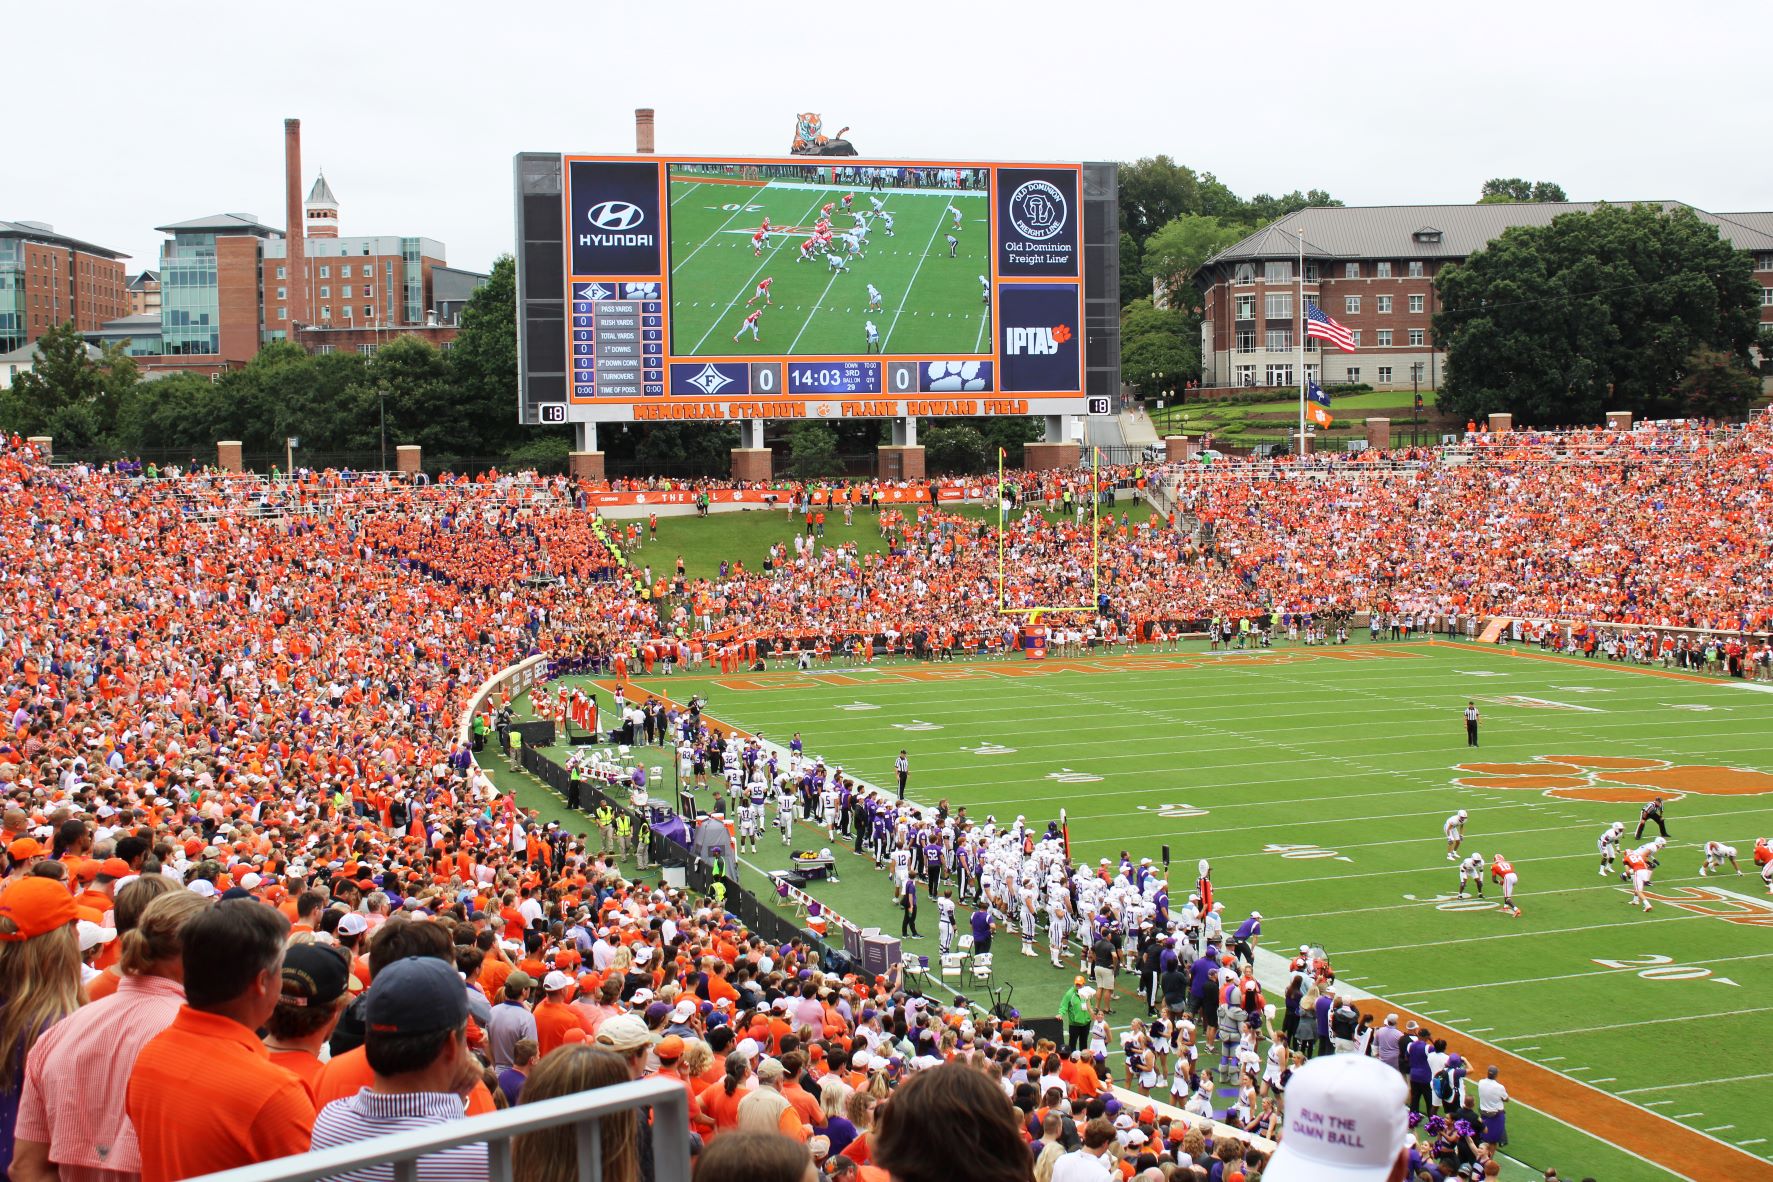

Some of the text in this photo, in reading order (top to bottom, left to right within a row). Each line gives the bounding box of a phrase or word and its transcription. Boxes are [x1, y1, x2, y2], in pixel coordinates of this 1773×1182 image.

[1015, 183, 1062, 203] OLD DOMINION
[1016, 220, 1061, 236] FREIGHT LINE
[580, 234, 653, 246] HYUNDAI
[1005, 242, 1072, 251] Old Dominion
[1009, 254, 1044, 266] Freight
[581, 304, 586, 312] 0
[649, 303, 655, 311] 0
[581, 317, 587, 325] 0
[649, 317, 655, 325] 0
[581, 332, 587, 340] 0
[650, 331, 655, 339] 0
[1006, 327, 1059, 355] IPTAY
[581, 344, 587, 352] 0
[650, 344, 655, 352] 0
[581, 359, 587, 367] 0
[650, 358, 656, 366] 0
[582, 372, 588, 380] 0
[650, 371, 656, 379] 0
[704, 375, 715, 386] F
[760, 369, 773, 390] 0
[791, 370, 841, 386] 14:03
[896, 369, 909, 389] 0
[578, 386, 592, 394] 0:00
[633, 400, 1029, 420] MEMORIAL STADIUM FRANK HOWARD FIELD
[1095, 400, 1107, 412] 18
[550, 407, 562, 420] 18
[691, 493, 718, 501] HL
[682, 751, 691, 760] 83
[725, 755, 733, 764] 32
[733, 773, 737, 781] 2
[753, 786, 762, 796] 55
[784, 800, 790, 808] 11
[826, 796, 830, 804] 5
[898, 855, 906, 866] 12
[927, 849, 938, 861] 52
[1590, 954, 1713, 980] 20
[1300, 1108, 1356, 1132] RUN THE
[1292, 1120, 1365, 1148] DAMN BALL
